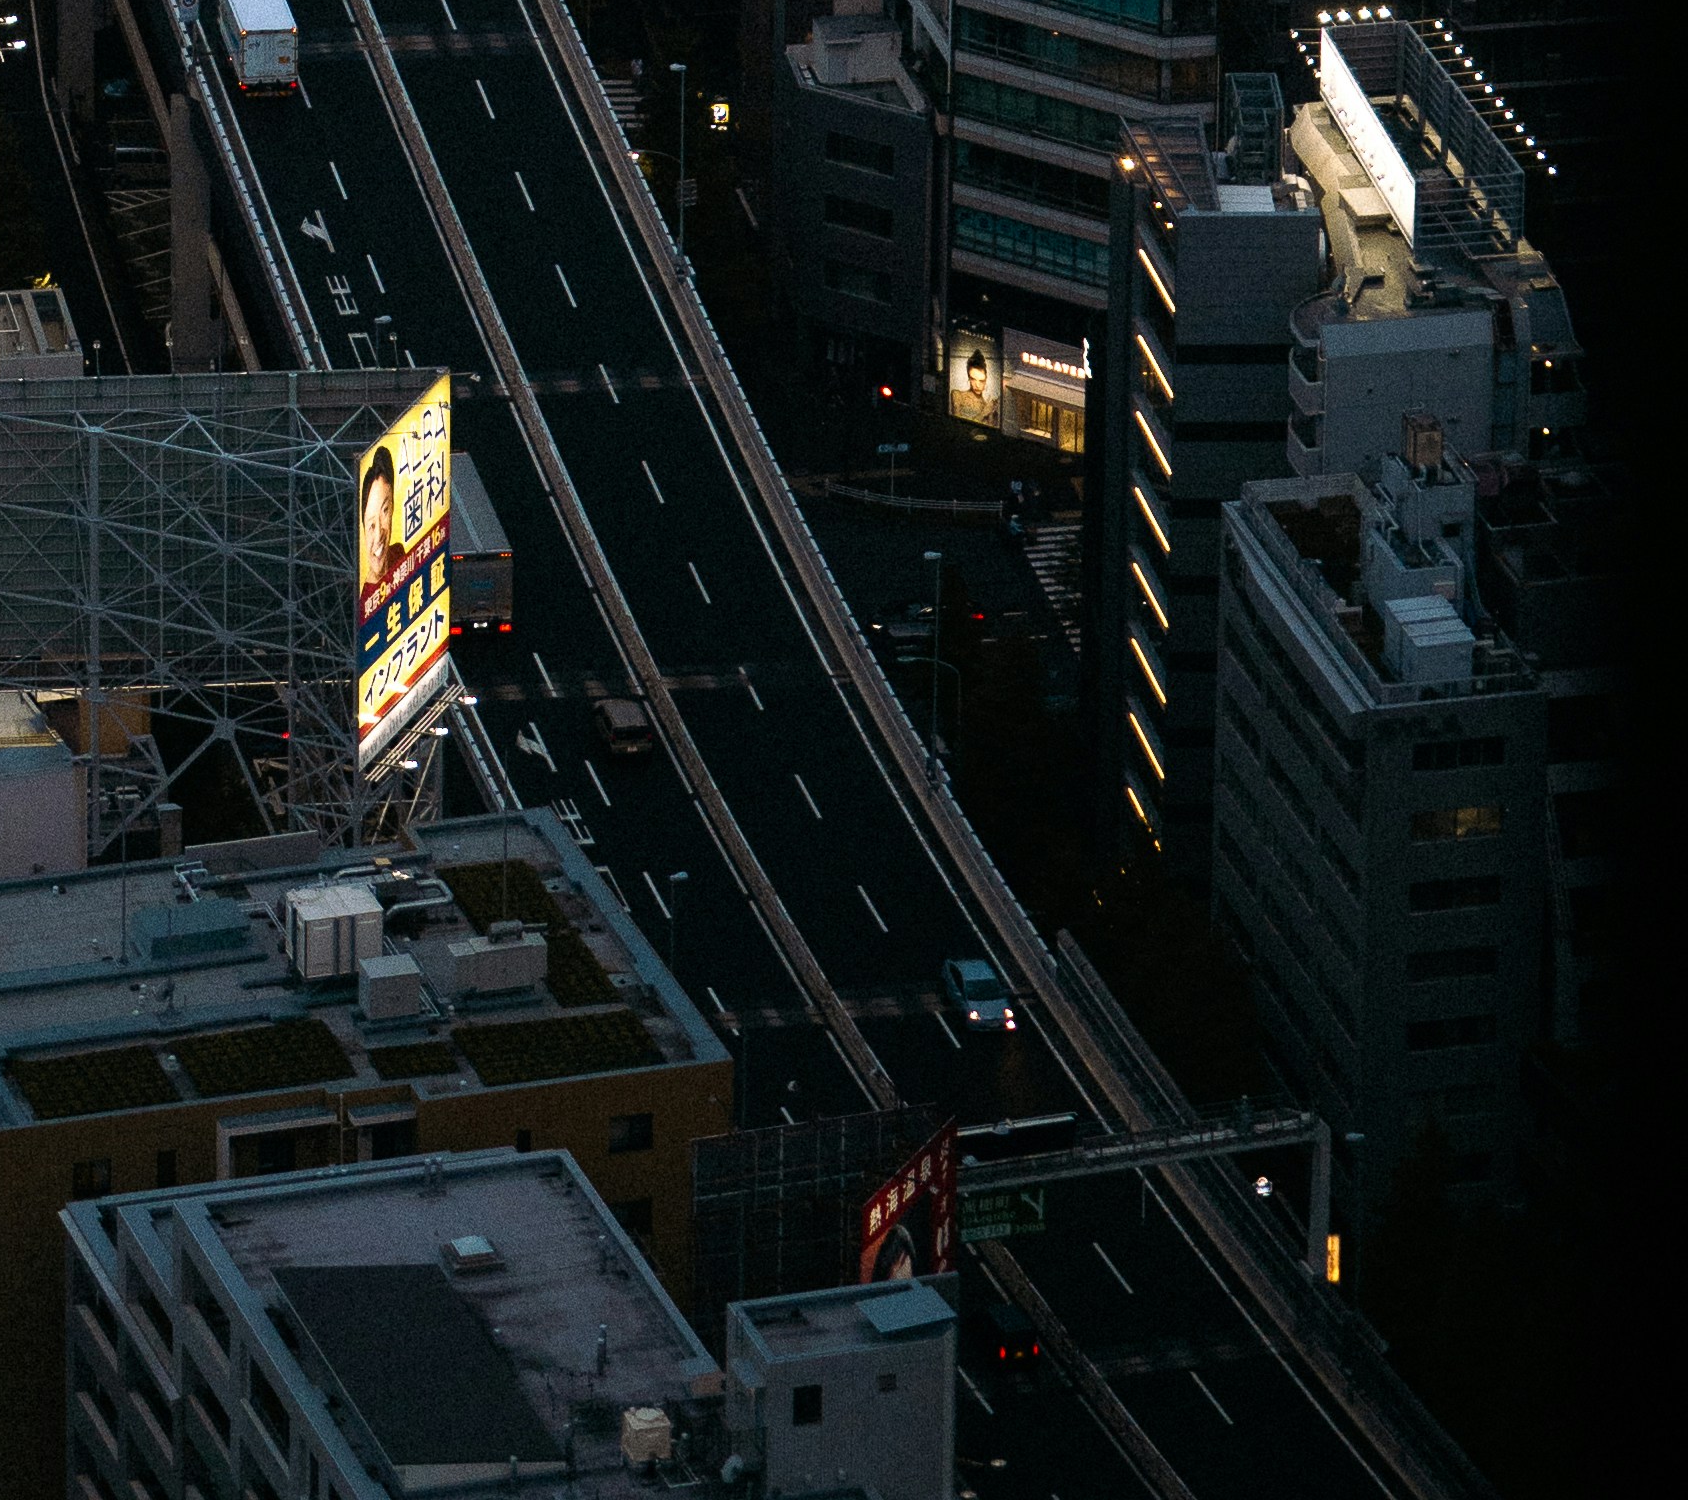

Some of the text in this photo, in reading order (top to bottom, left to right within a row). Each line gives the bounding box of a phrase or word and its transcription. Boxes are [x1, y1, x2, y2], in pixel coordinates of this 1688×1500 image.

[397, 399, 448, 486] ALBA
[403, 460, 447, 543] 歯科
[363, 551, 447, 652] 一生保証
[364, 608, 446, 706] インプラント
